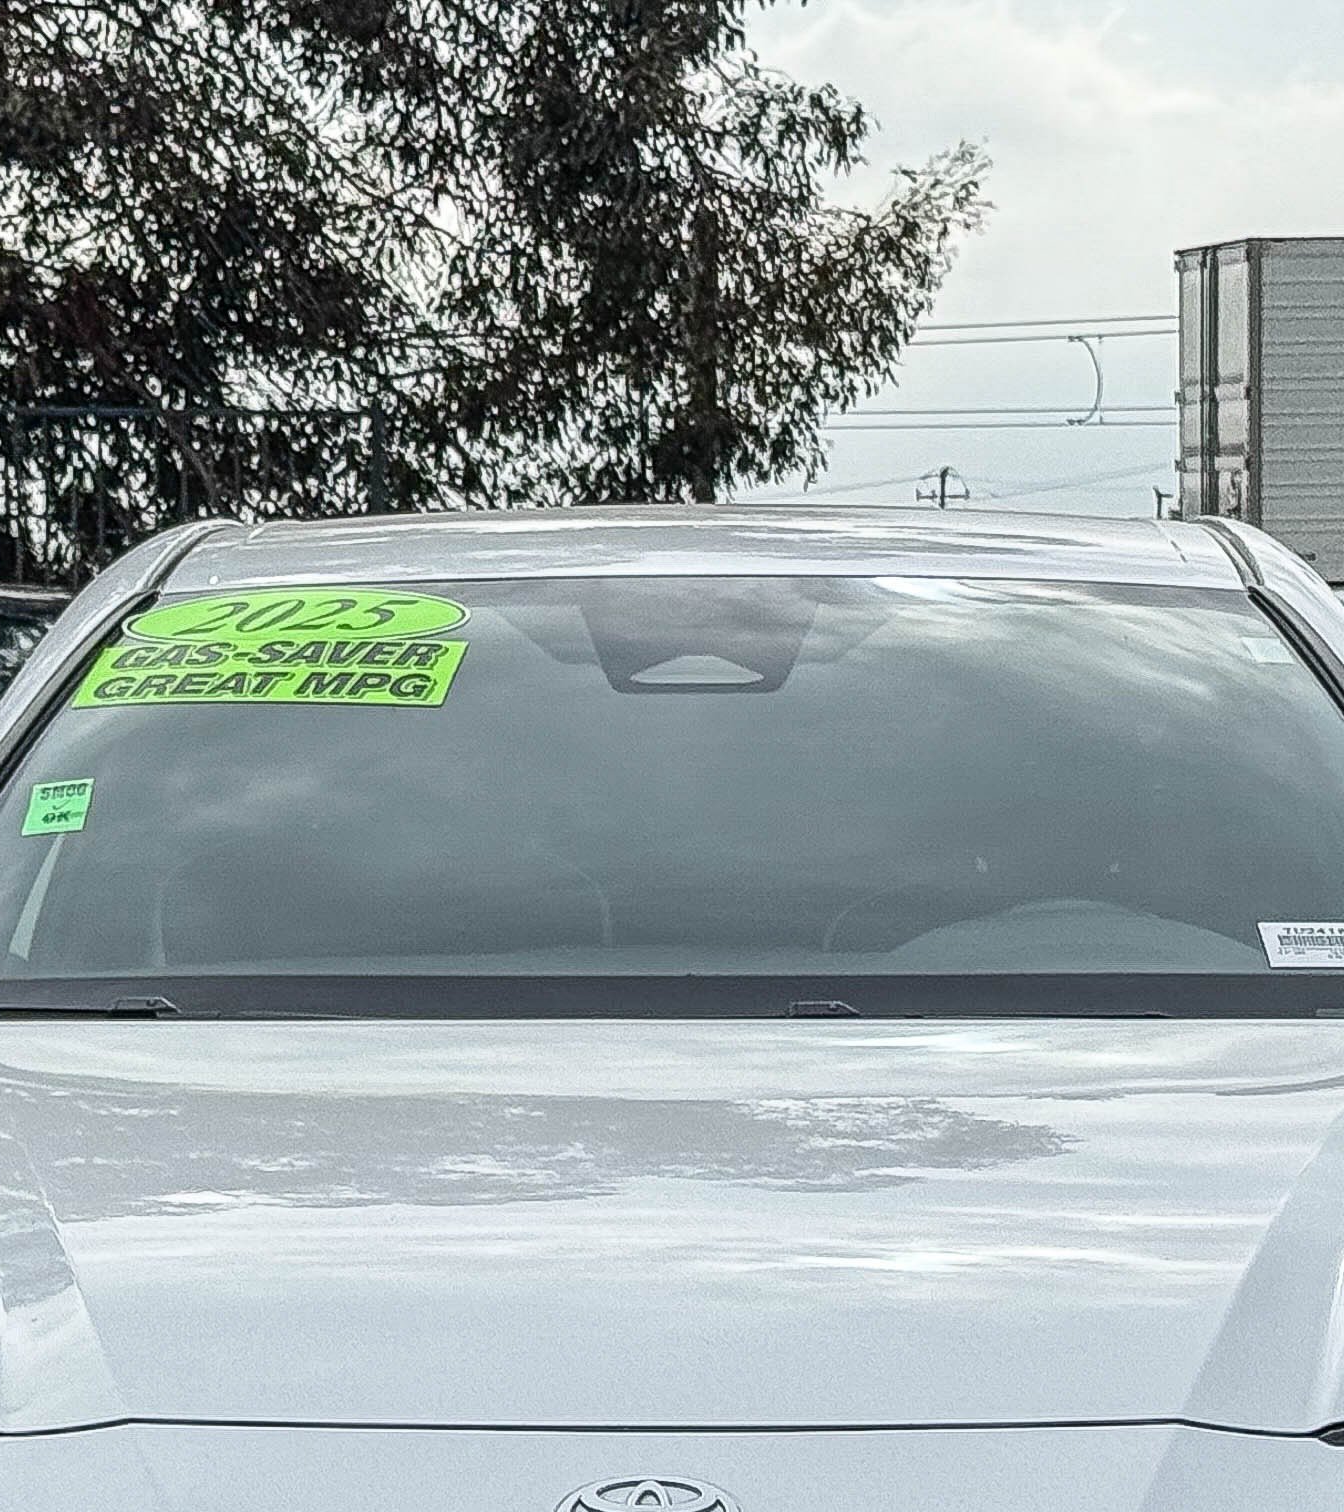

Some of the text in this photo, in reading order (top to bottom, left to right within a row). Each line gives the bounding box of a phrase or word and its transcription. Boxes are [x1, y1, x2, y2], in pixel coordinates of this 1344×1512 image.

[171, 598, 419, 637] 2025
[110, 641, 450, 671] GAS-SAVER
[92, 671, 440, 701] GREAT MPG
